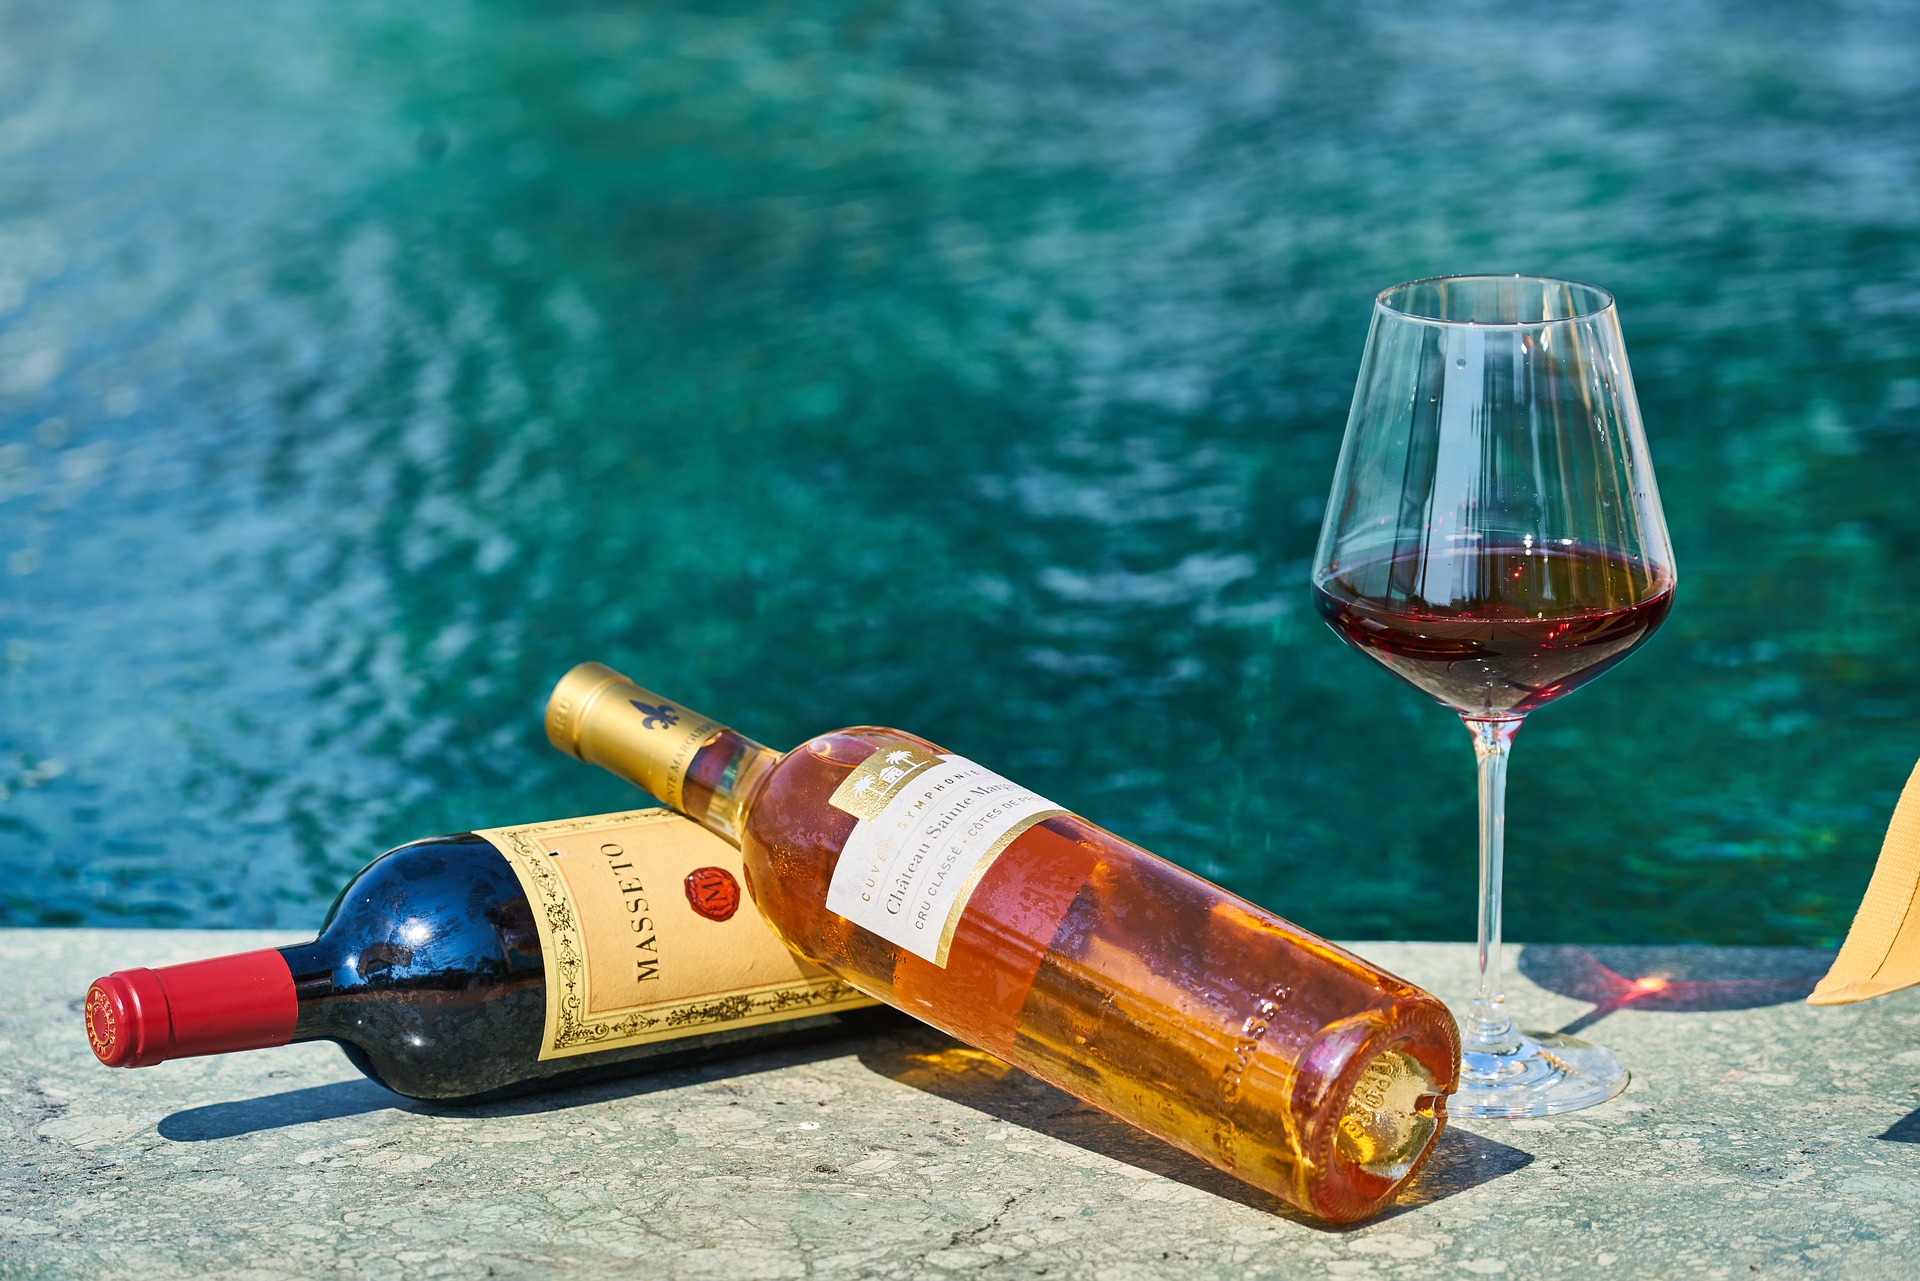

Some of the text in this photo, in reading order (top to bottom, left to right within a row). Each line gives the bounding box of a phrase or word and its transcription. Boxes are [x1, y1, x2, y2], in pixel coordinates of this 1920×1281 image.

[886, 843, 931, 915] Château
[926, 796, 975, 839] Sainte
[898, 769, 980, 830] SYMPHONIE
[600, 843, 660, 983] MASSETO
[915, 902, 931, 930] CRU
[927, 846, 963, 897] CLASSÉ
[967, 808, 1003, 837] CÔTES
[1002, 799, 1019, 809] DE
